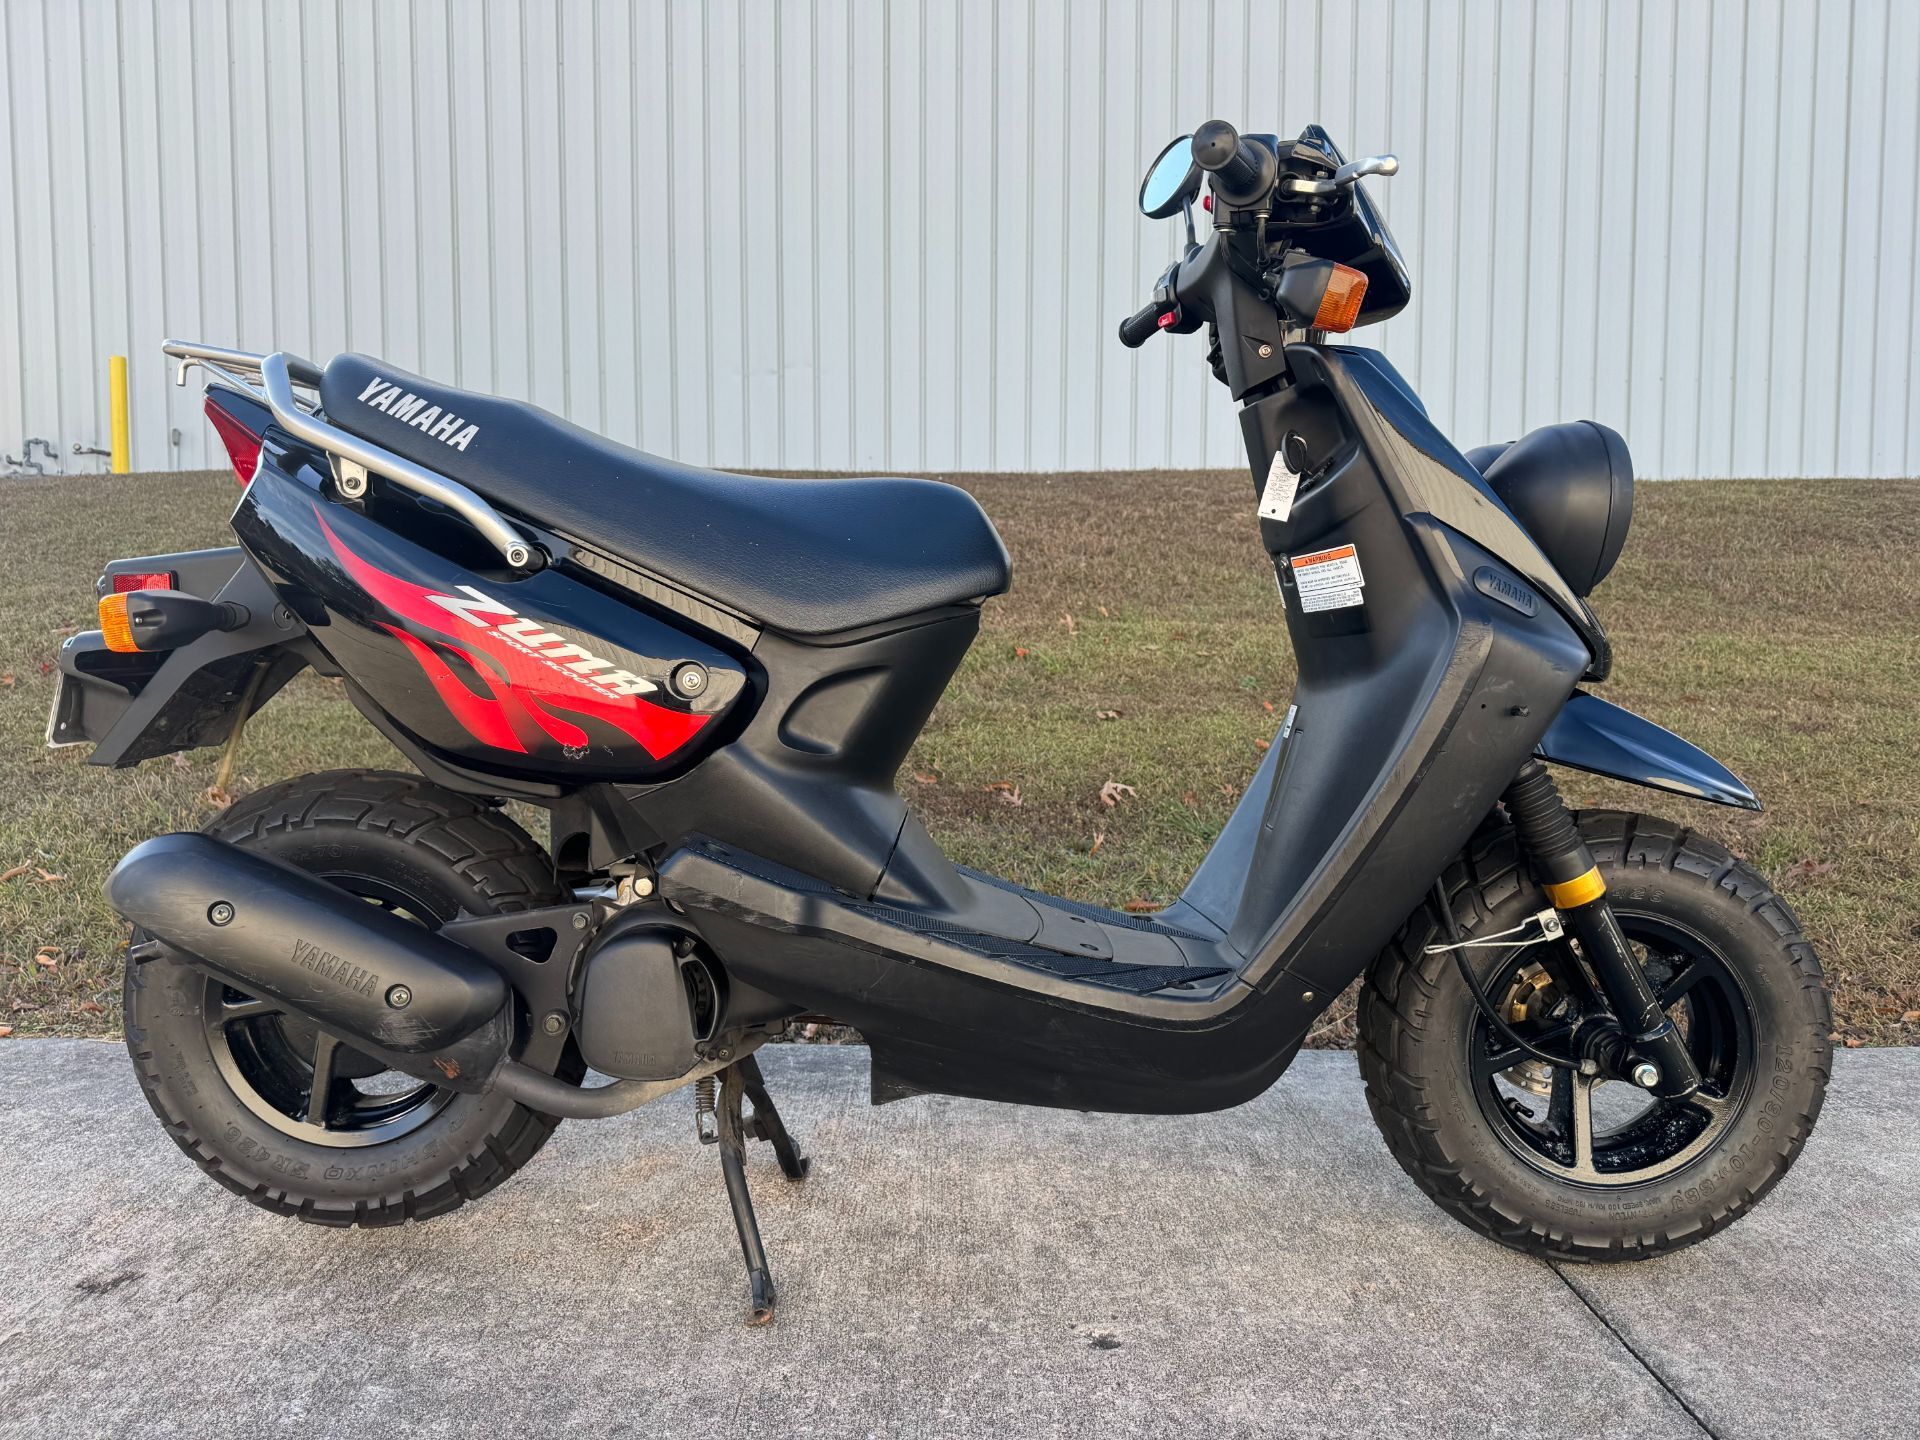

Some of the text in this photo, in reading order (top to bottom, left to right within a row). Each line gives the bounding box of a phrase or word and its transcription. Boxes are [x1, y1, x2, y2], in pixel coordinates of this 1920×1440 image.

[357, 376, 480, 452] YAMAHA
[1489, 572, 1532, 609] YAMAHA
[486, 630, 621, 700] SPORT SCOOTER
[290, 938, 380, 999] YAMAHA
[1729, 1043, 1793, 1173] 120/90-10
